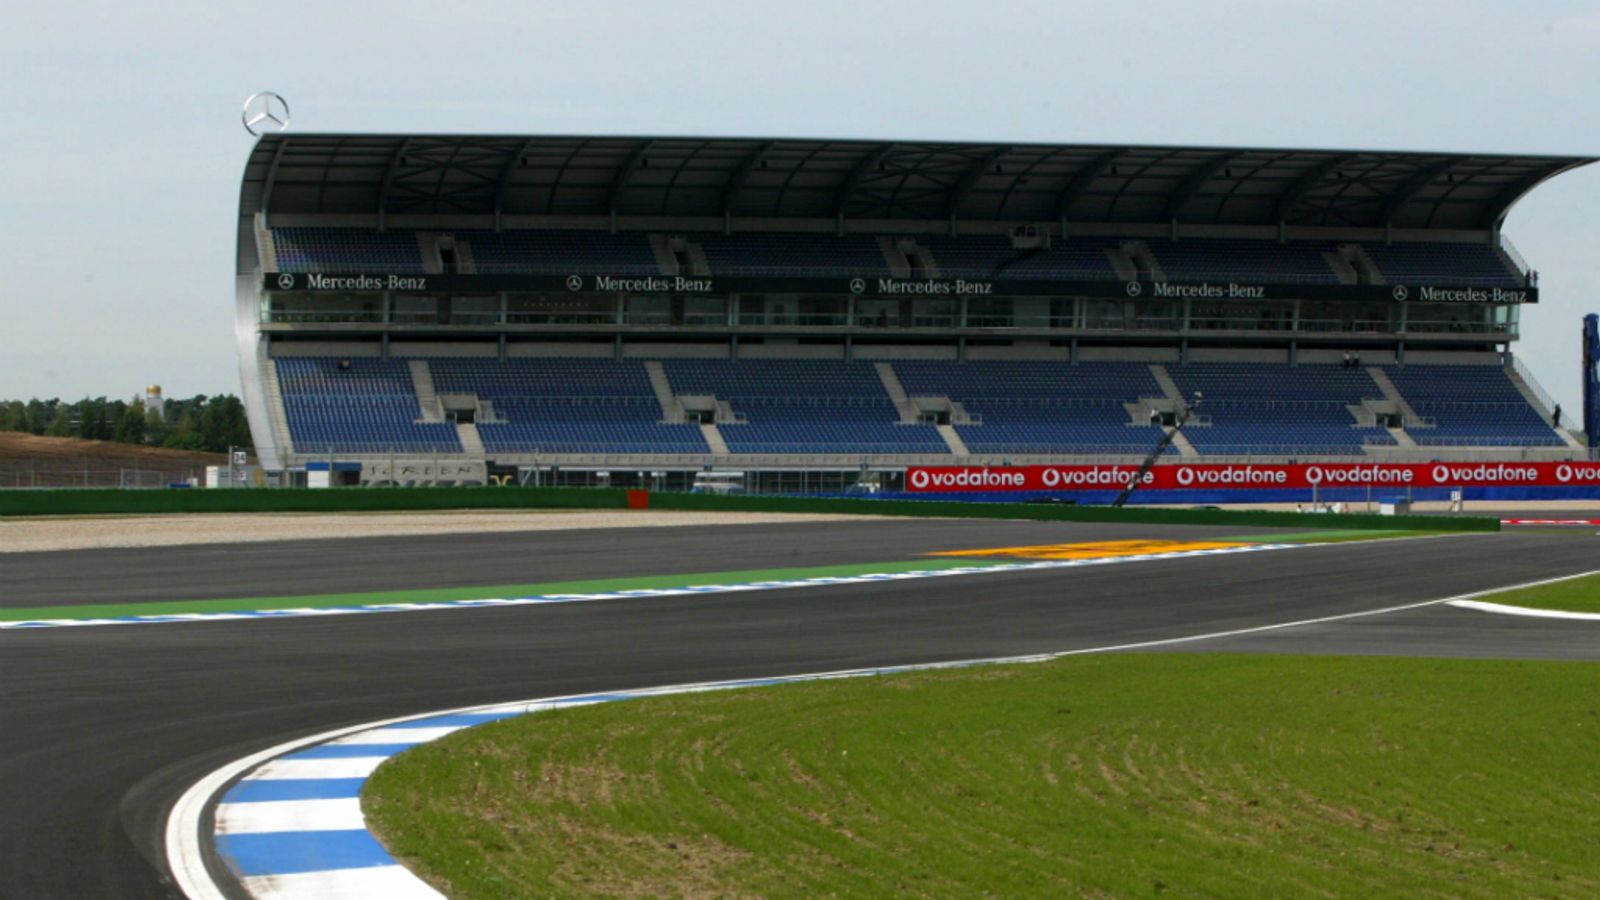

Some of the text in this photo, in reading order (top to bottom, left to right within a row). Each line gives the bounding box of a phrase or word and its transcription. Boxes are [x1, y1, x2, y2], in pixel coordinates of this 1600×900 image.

[307, 274, 425, 289] Mercedes-Benz
[595, 276, 712, 291] Mercedes-Benz
[878, 279, 992, 294] Mercedes-Benz
[1153, 282, 1265, 297] Mercedes-Benz
[1419, 286, 1527, 302] Mercedes-Benz
[931, 469, 1025, 486] vodafone
[1196, 467, 1288, 484] vodafone
[1325, 466, 1414, 483] vodafone
[1451, 465, 1538, 482] vodafone
